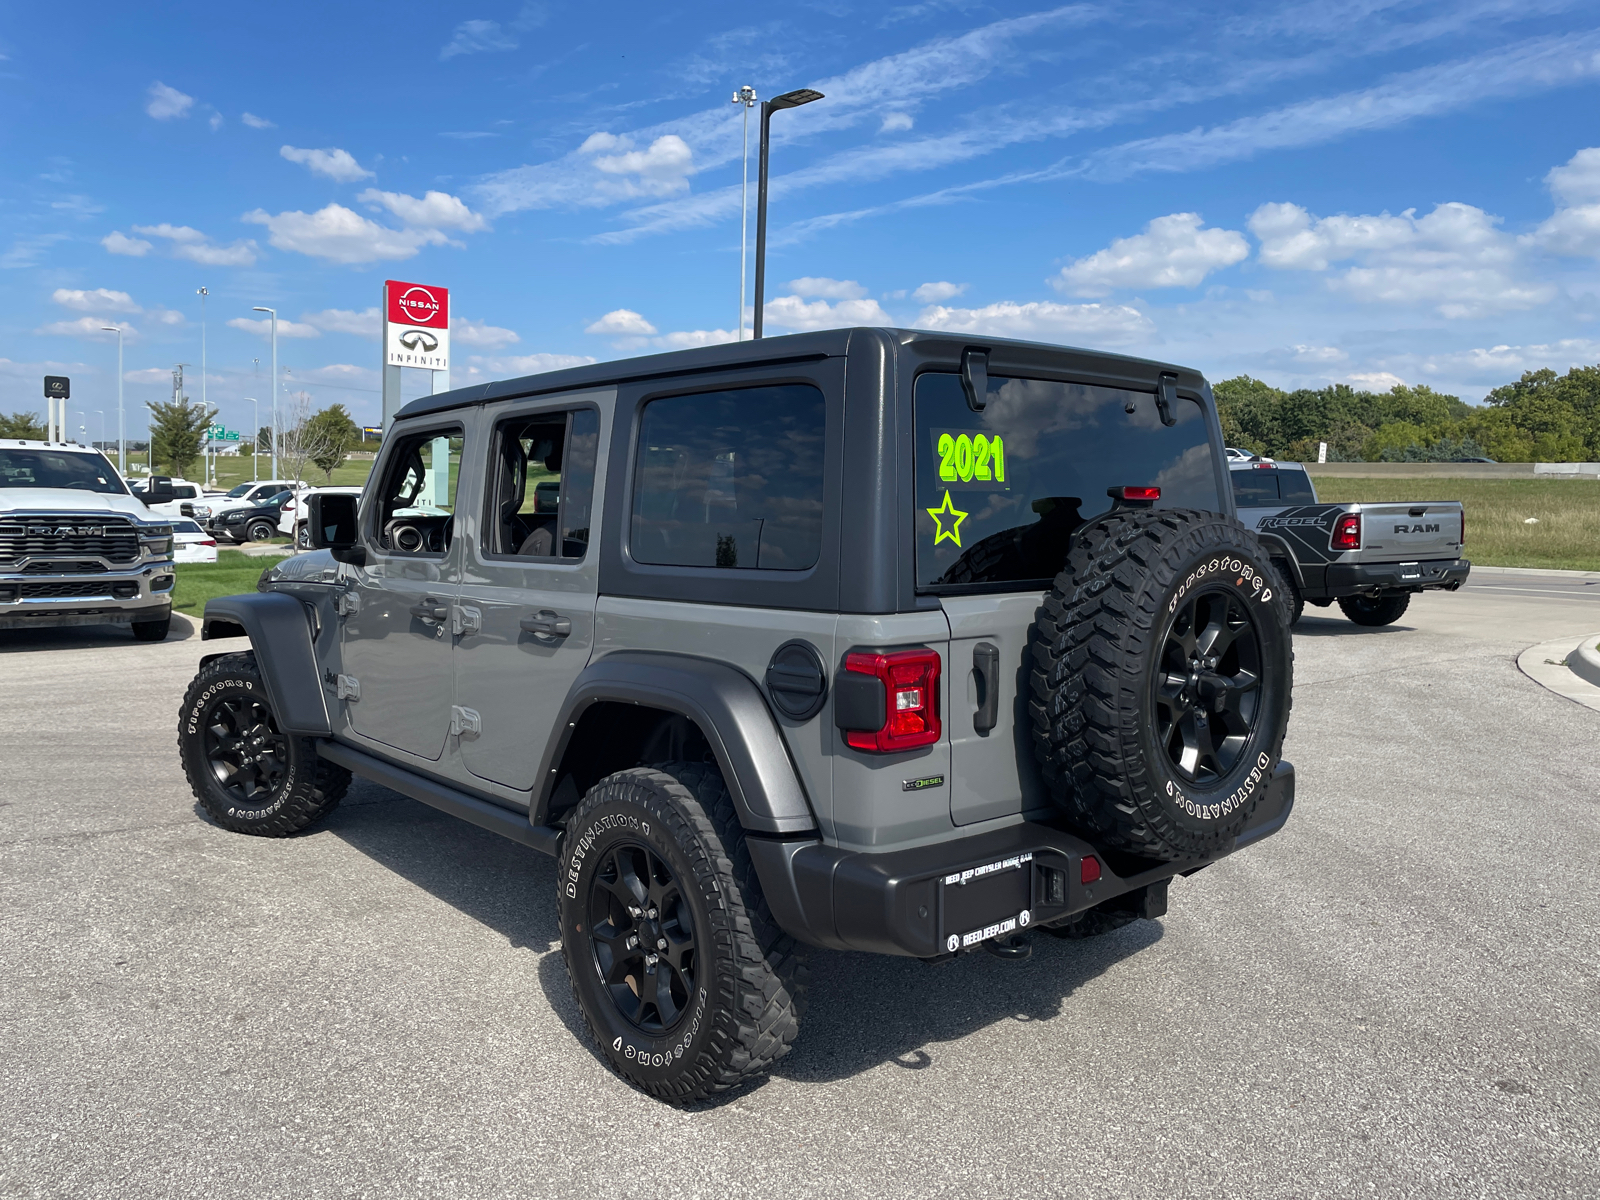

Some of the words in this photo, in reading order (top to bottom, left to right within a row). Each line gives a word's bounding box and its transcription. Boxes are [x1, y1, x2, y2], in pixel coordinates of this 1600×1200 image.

[399, 299, 439, 310] NISSAN
[390, 353, 446, 367] INFINITI
[938, 433, 1005, 483] 2021
[27, 526, 102, 536] RAM
[1257, 516, 1328, 528] REBEL
[1393, 524, 1440, 534] RAM
[236, 764, 297, 820] DESTINATION
[1175, 751, 1270, 819] DESTINATION
[566, 813, 640, 899] DESTINATION
[945, 872, 960, 885] REED
[961, 868, 974, 880] JEEP
[975, 861, 1002, 876] CHRYSLER
[1003, 856, 1020, 869] DODGE
[1020, 852, 1033, 863] RAM
[963, 918, 1016, 947] REEDJEEP.COM
